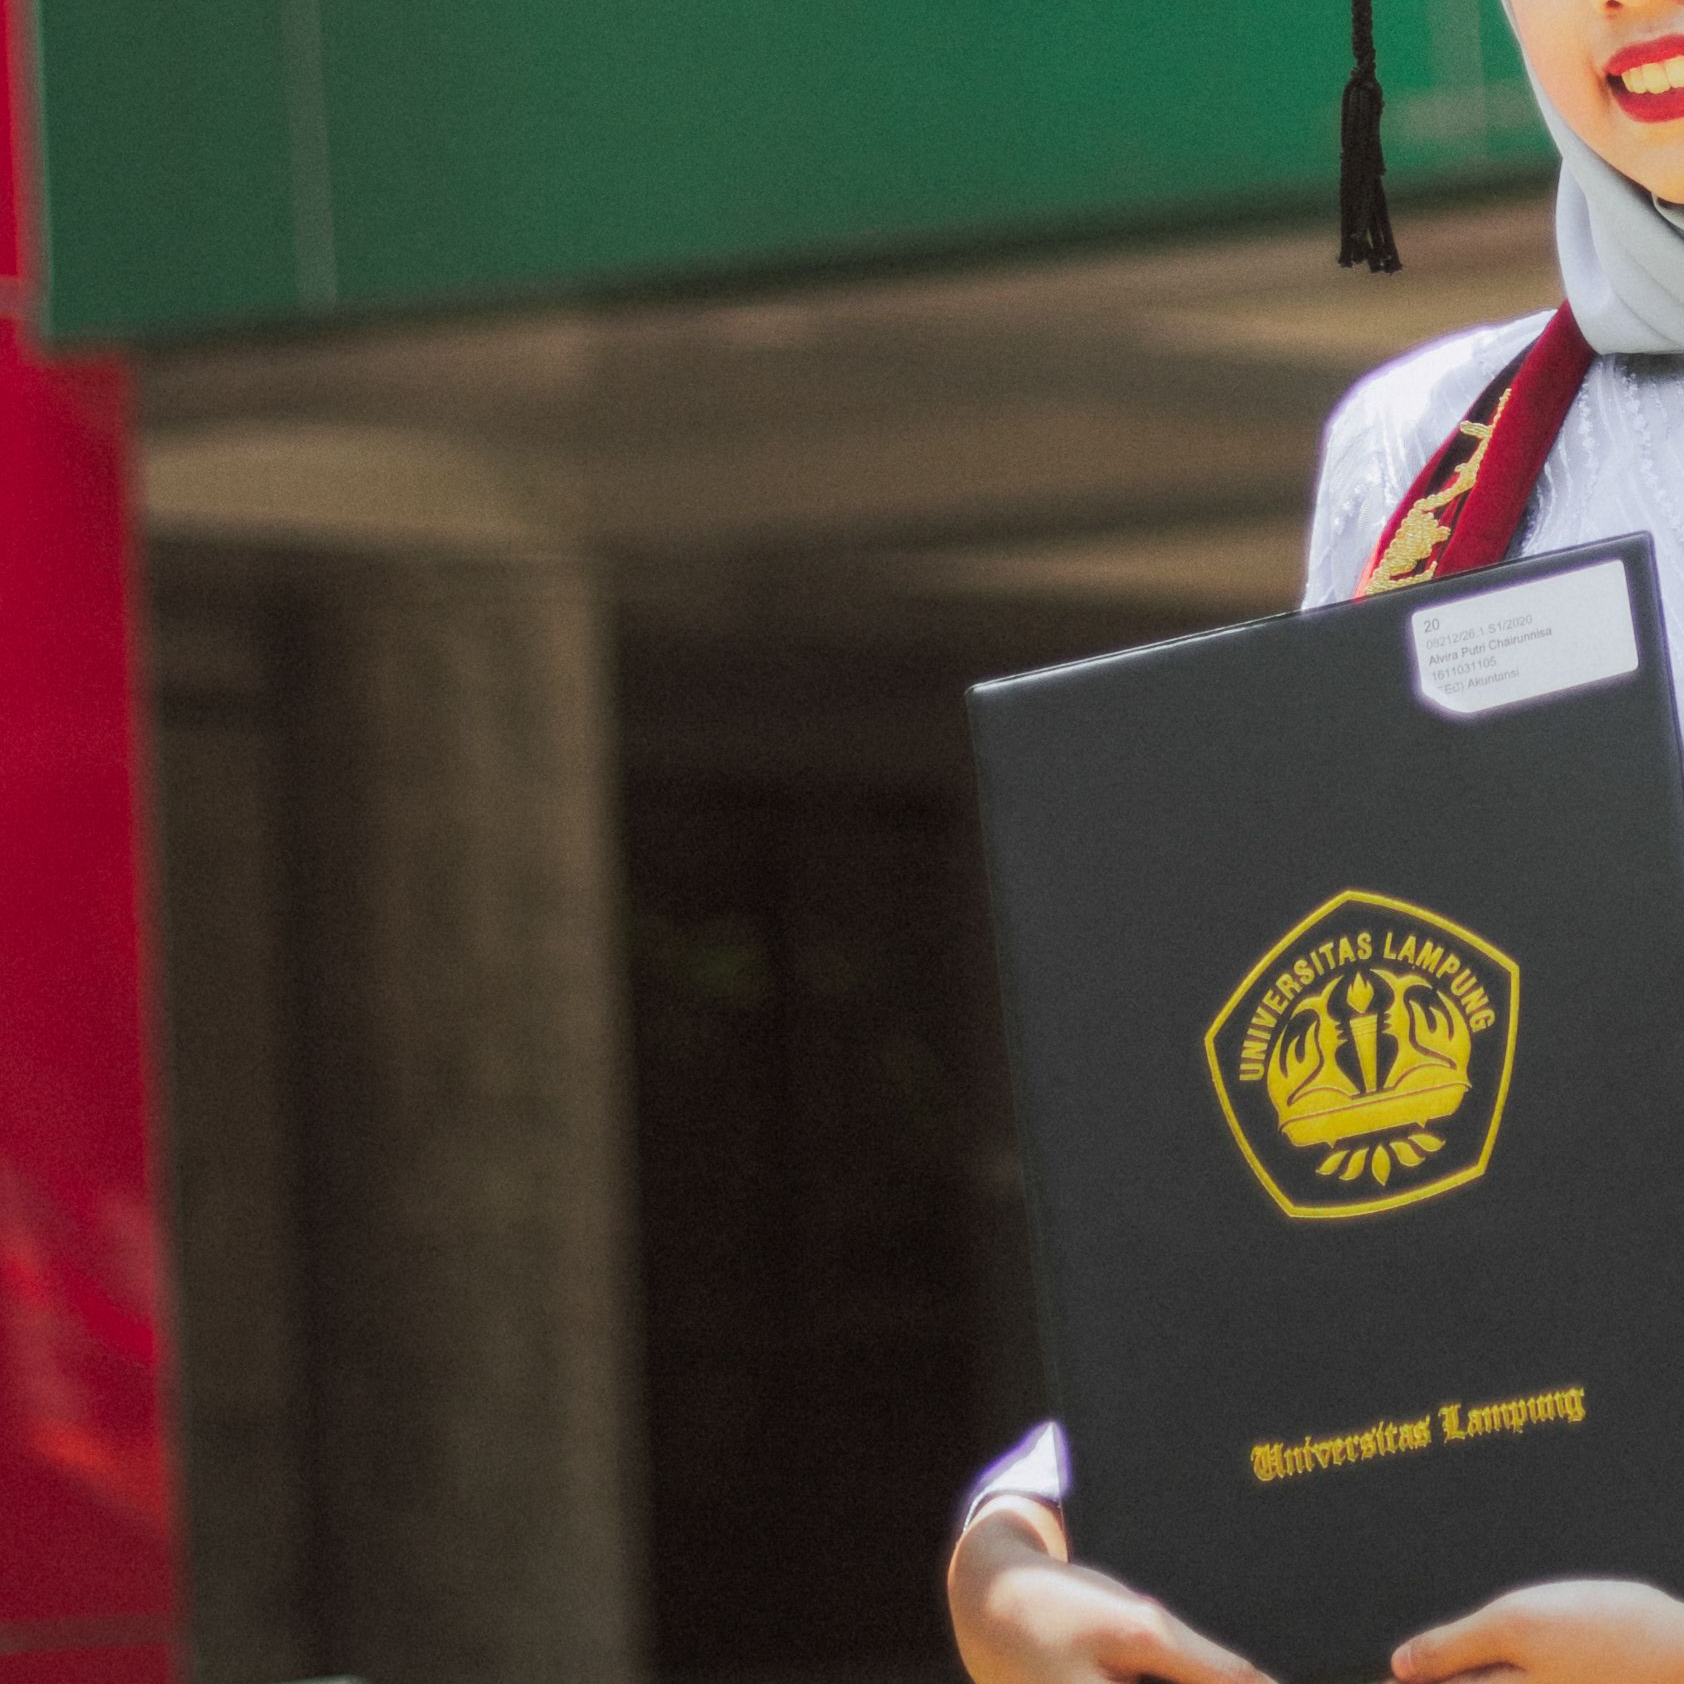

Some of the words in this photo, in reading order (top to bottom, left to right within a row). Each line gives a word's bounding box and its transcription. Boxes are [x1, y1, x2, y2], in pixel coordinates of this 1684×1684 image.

[1423, 617, 1440, 633] 20
[1428, 651, 1459, 666] Alvira
[1461, 644, 1486, 658] Putri
[1488, 627, 1553, 651] Chairunnisa
[1467, 667, 1520, 690] Akuntansi
[1238, 931, 1373, 1082] UNIVERSITAS
[1383, 930, 1497, 1035] LAMPUNG
[1250, 1414, 1432, 1482] Universitas
[1437, 1385, 1587, 1444] Lampung
